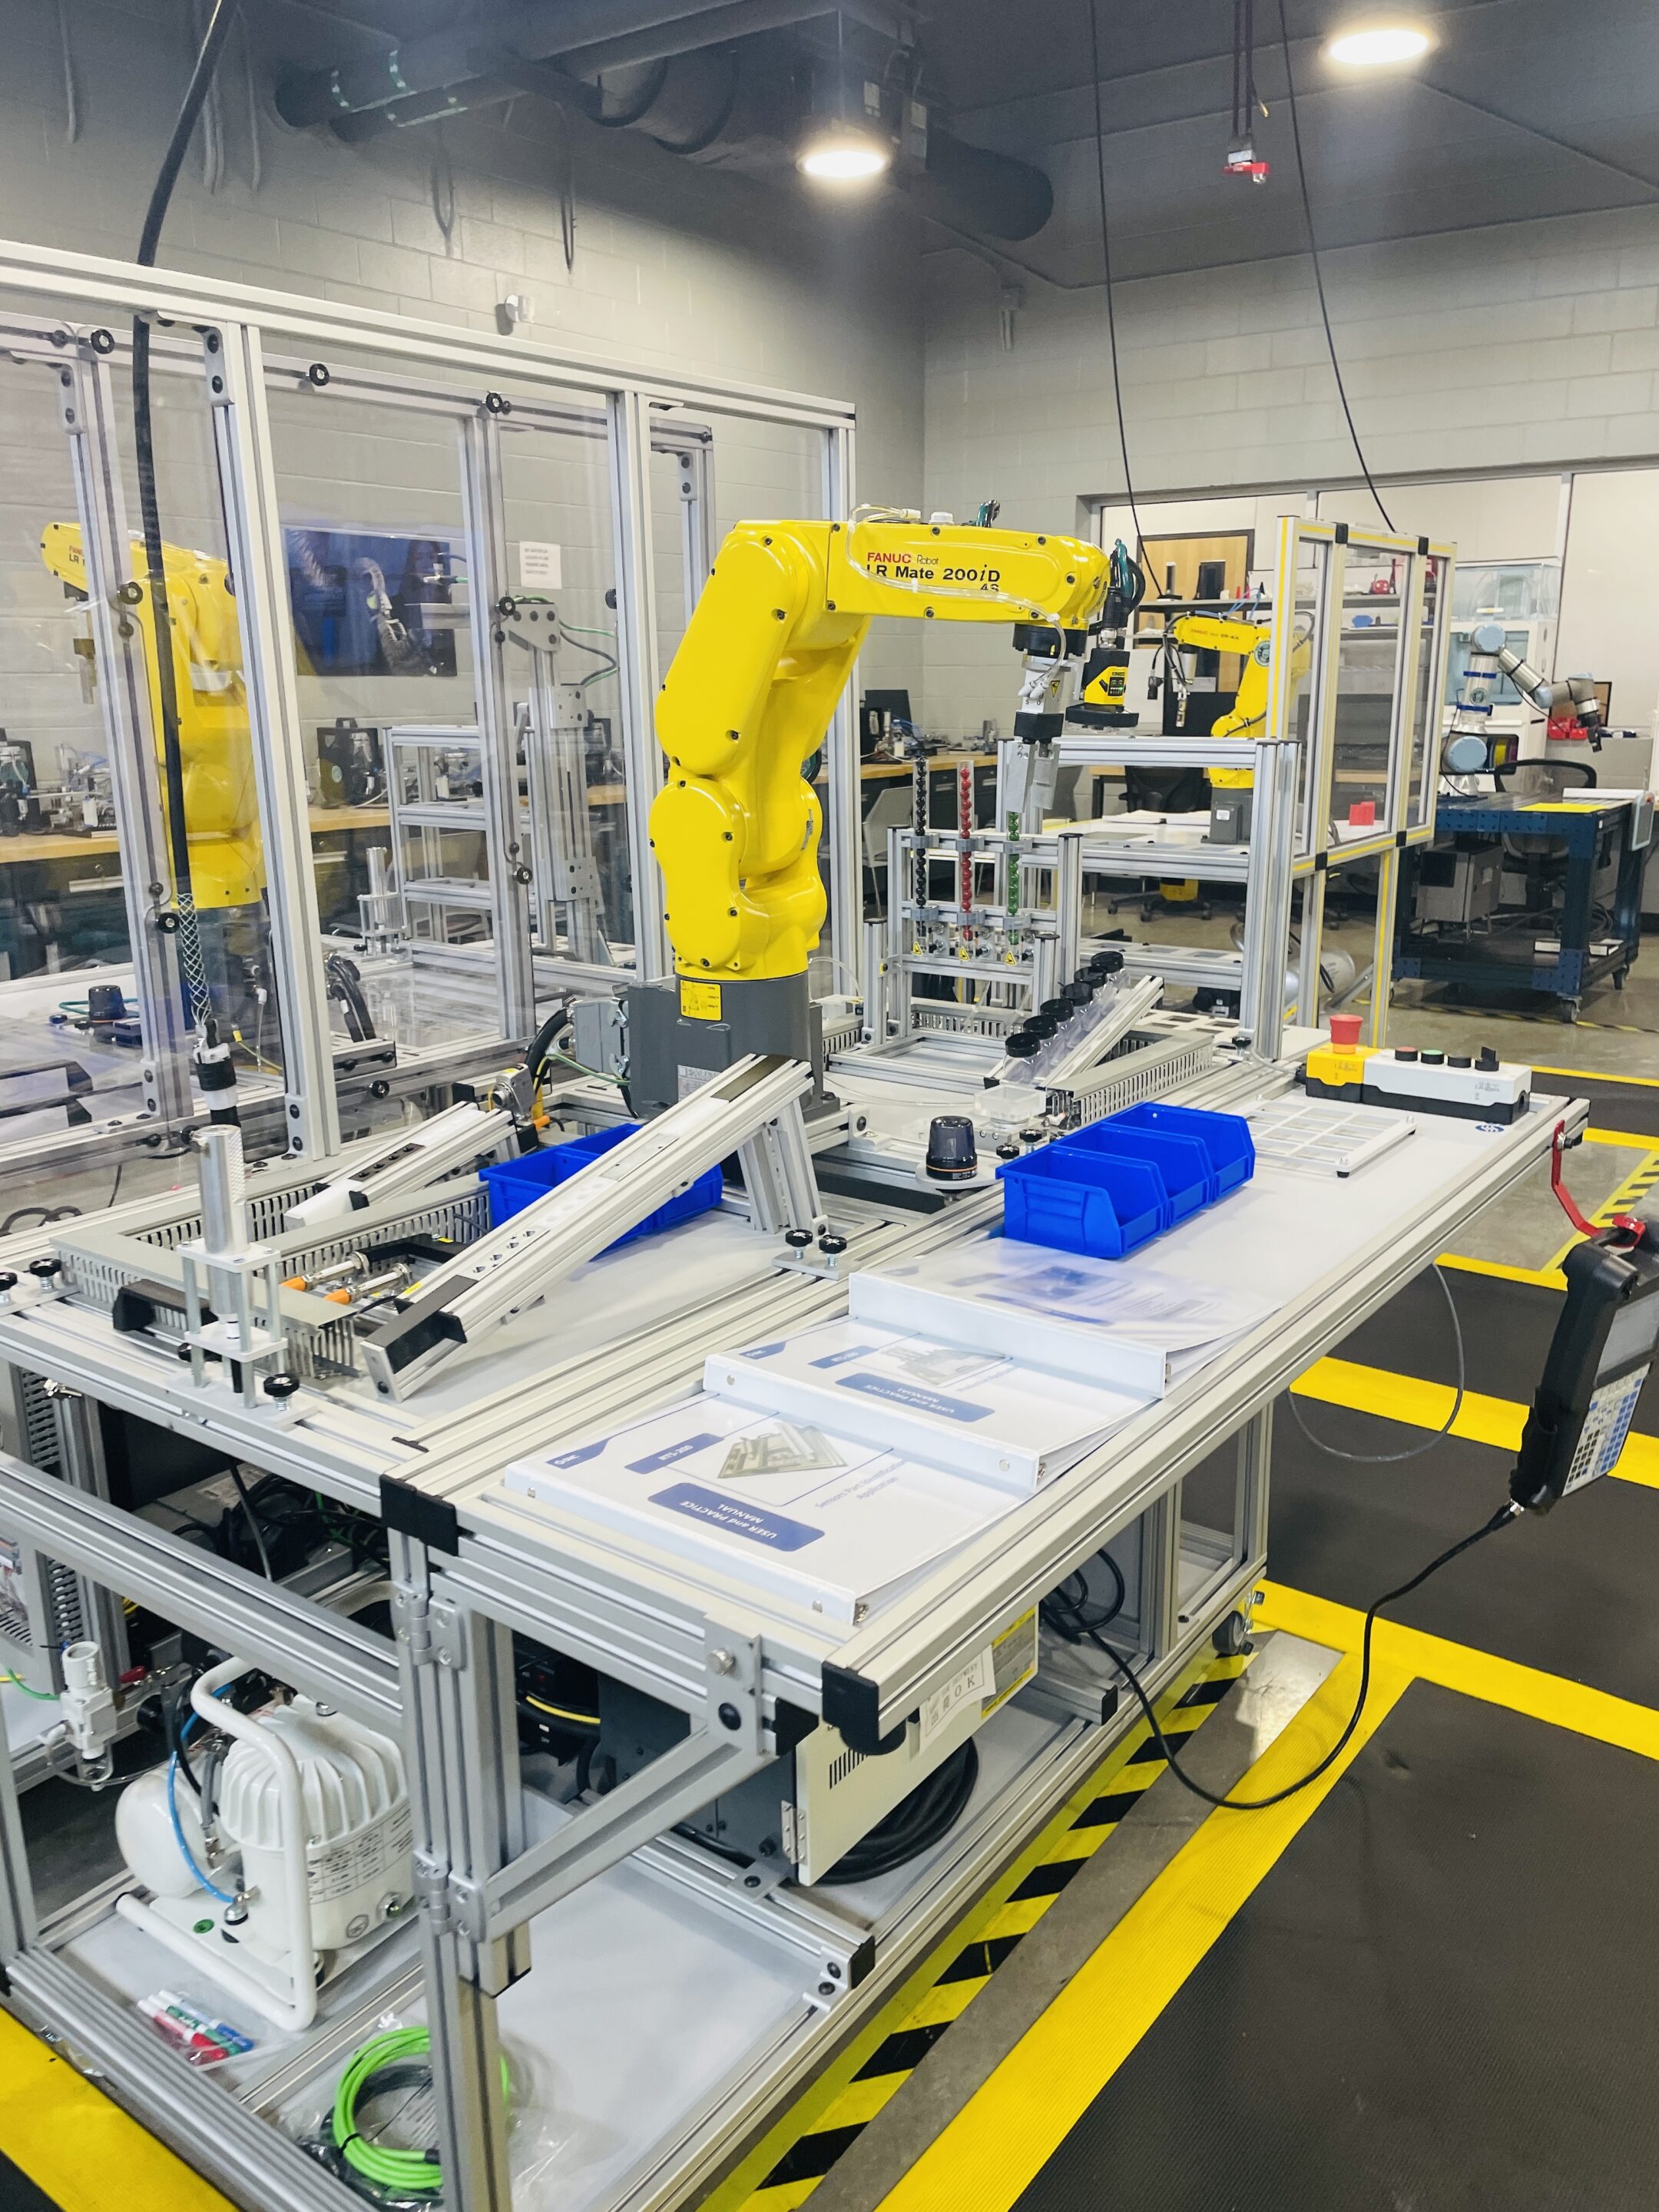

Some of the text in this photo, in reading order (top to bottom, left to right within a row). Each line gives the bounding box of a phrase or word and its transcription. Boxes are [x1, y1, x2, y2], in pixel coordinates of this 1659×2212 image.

[867, 552, 939, 565] FANUC Robot
[896, 566, 934, 579] Mate
[943, 565, 1000, 582] 200iD
[679, 1500, 778, 1539] USER and PRACTICE
[717, 1503, 765, 1524] MANUAL
